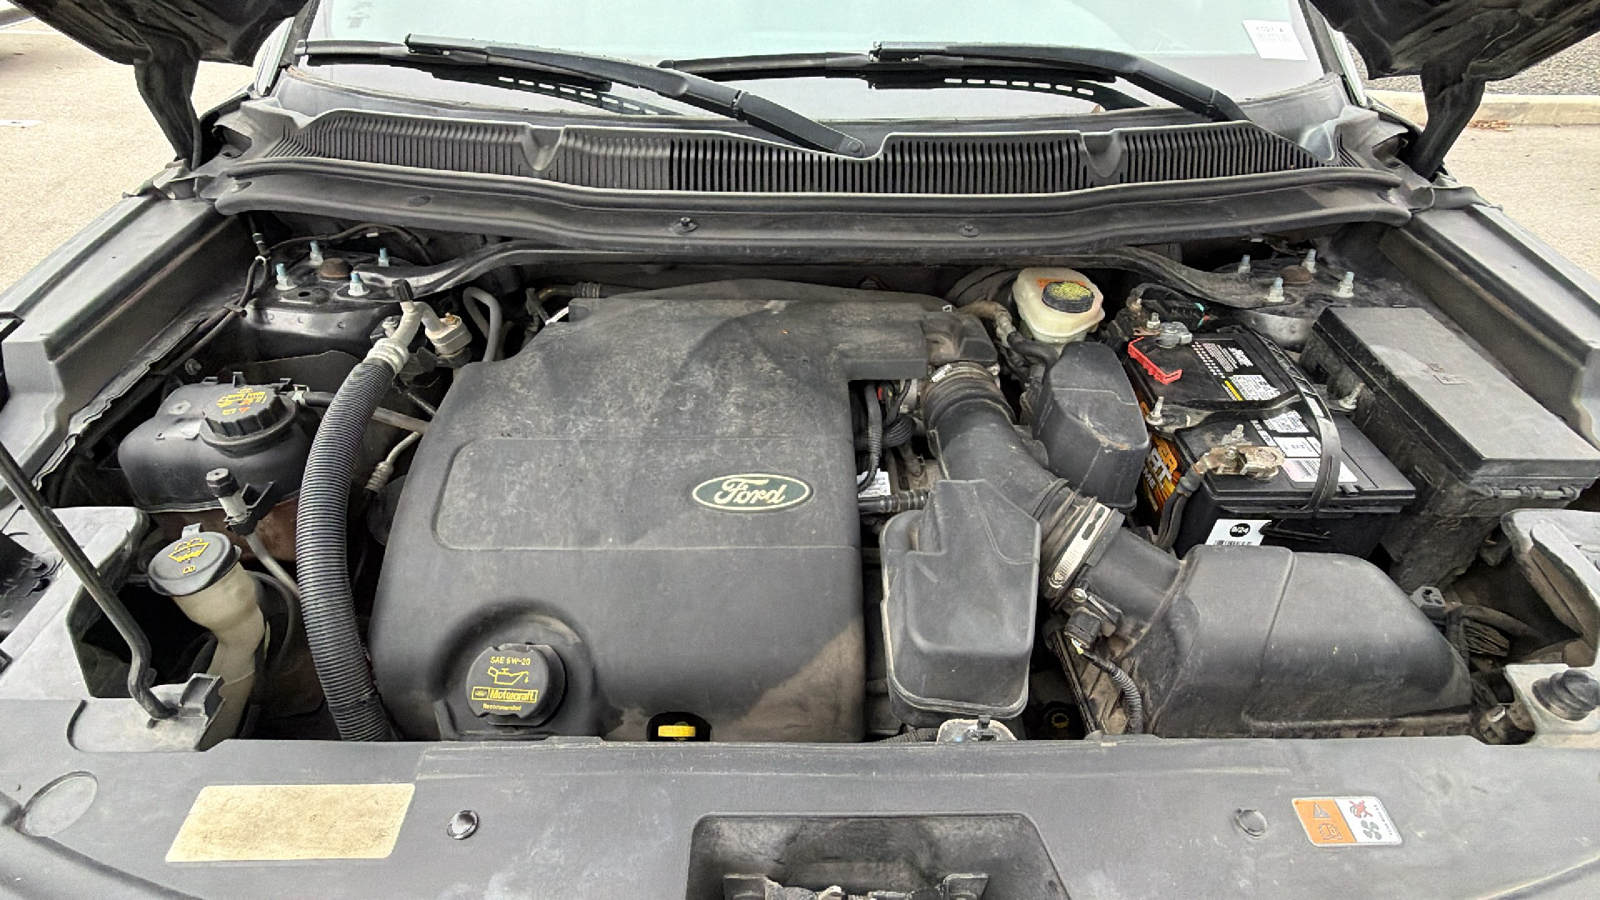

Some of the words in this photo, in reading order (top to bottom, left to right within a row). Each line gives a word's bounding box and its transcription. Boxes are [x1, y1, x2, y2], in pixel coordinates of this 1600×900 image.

[714, 478, 787, 504] Ford
[490, 656, 505, 664] SAE
[489, 689, 535, 701] Motorcraft
